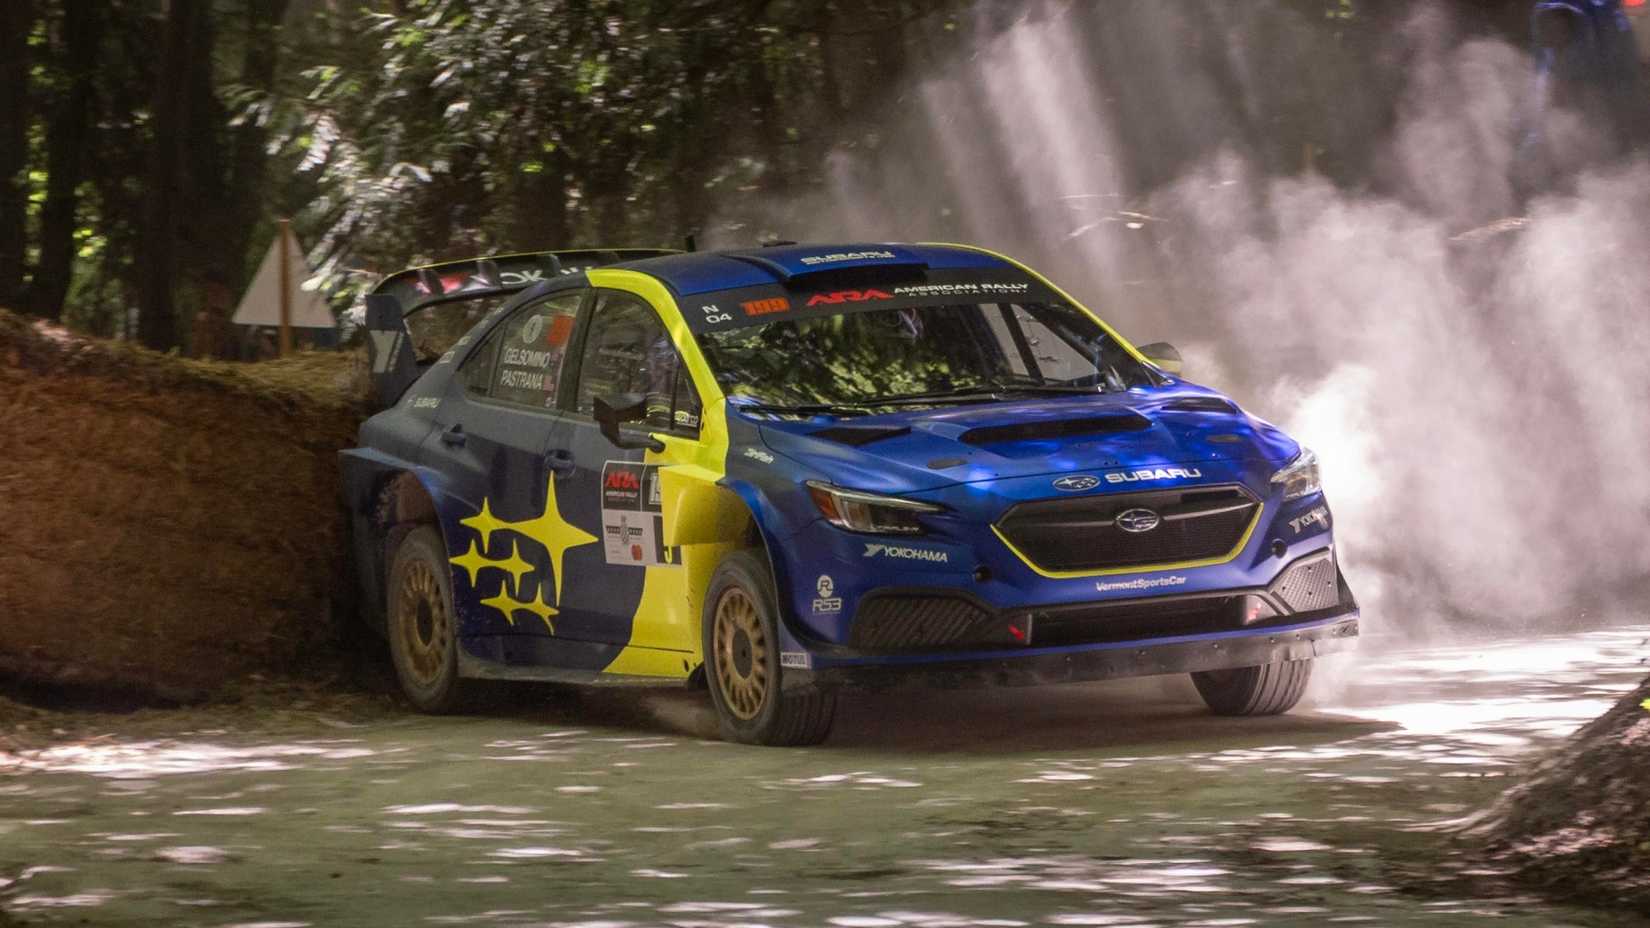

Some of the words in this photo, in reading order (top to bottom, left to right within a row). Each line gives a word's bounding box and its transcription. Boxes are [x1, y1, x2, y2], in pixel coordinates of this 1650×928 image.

[894, 283, 978, 294] AMERICAN
[806, 288, 893, 307] ARA
[702, 304, 719, 314] N
[706, 313, 732, 324] 04
[504, 347, 551, 368] GELSOMINO
[501, 369, 544, 391] PASTRANA
[1105, 468, 1202, 484] SUBARU
[884, 547, 948, 562] YOKOHAMA
[1096, 576, 1187, 592] VermontSportsCar
